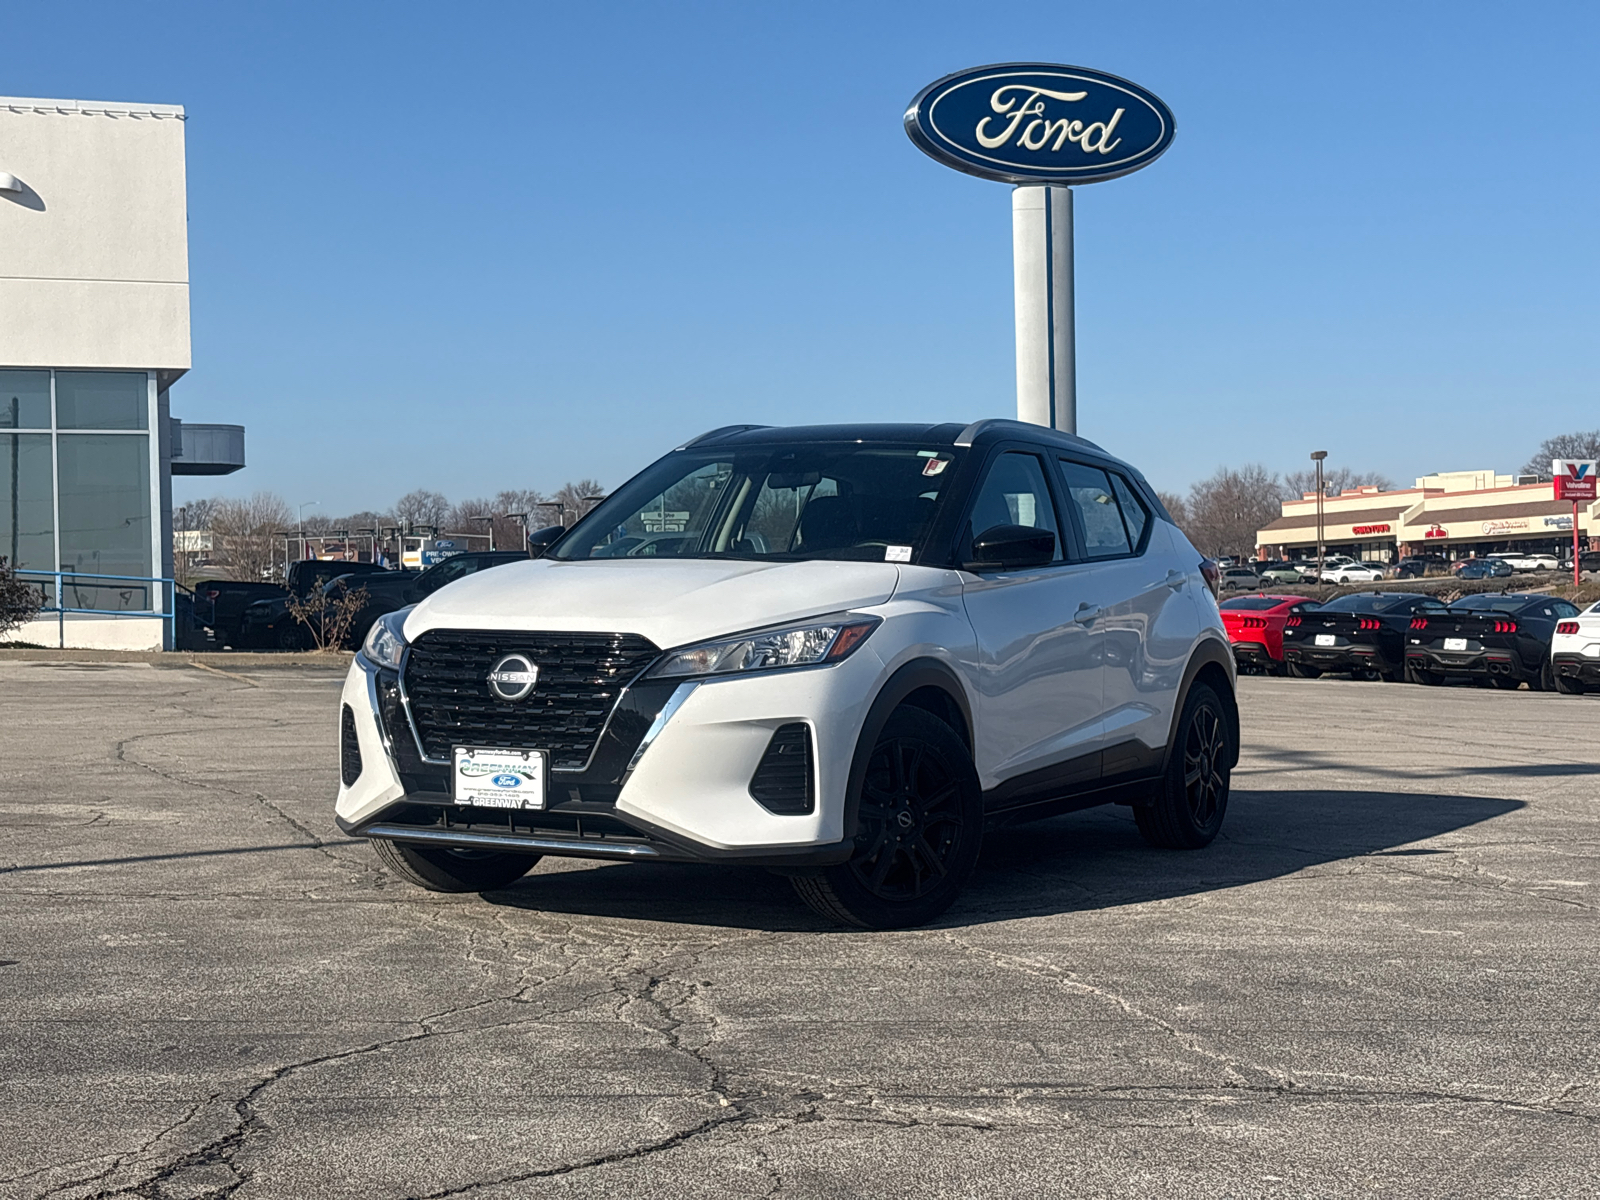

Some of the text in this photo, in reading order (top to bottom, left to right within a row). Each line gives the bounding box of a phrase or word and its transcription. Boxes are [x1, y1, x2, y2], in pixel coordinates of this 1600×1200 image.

[975, 84, 1125, 155] Ford
[490, 673, 535, 681] NISSAN
[459, 759, 537, 774] GREENWAY
[497, 776, 516, 786] Ford
[473, 797, 523, 809] GREENWAY
